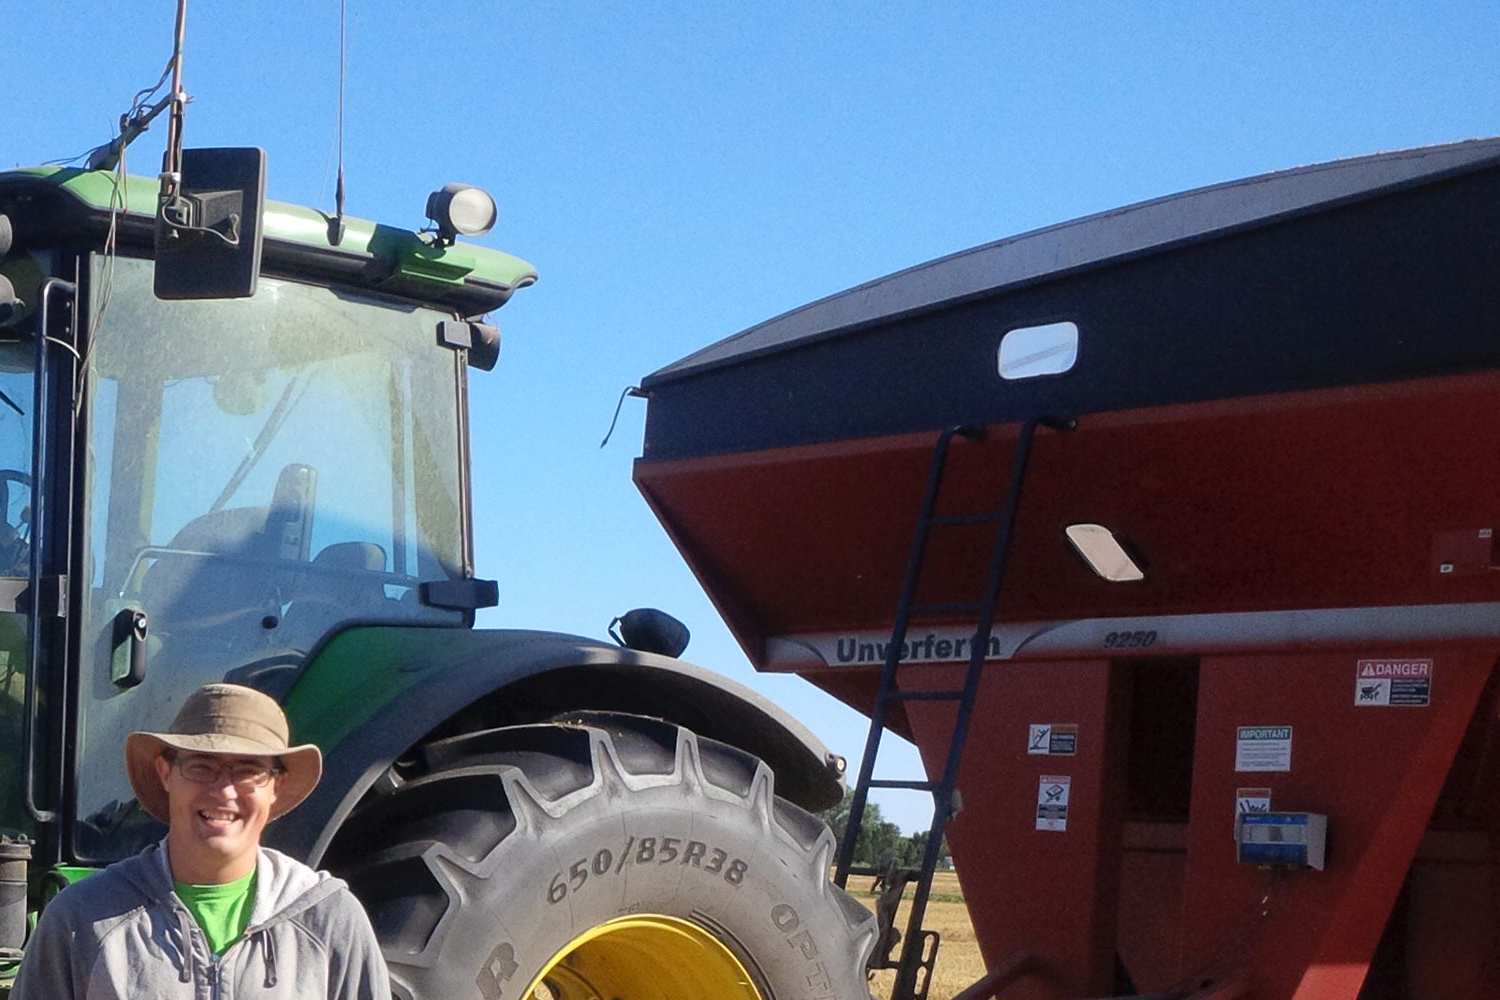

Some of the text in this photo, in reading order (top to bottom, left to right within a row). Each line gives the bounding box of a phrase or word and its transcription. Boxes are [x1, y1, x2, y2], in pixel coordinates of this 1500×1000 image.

[836, 634, 1001, 663] Unverferh
[1103, 630, 1158, 649] 9250
[1375, 663, 1429, 675] DANGER
[1239, 728, 1290, 739] IMPORTANT
[547, 836, 749, 906] 650/85R38
